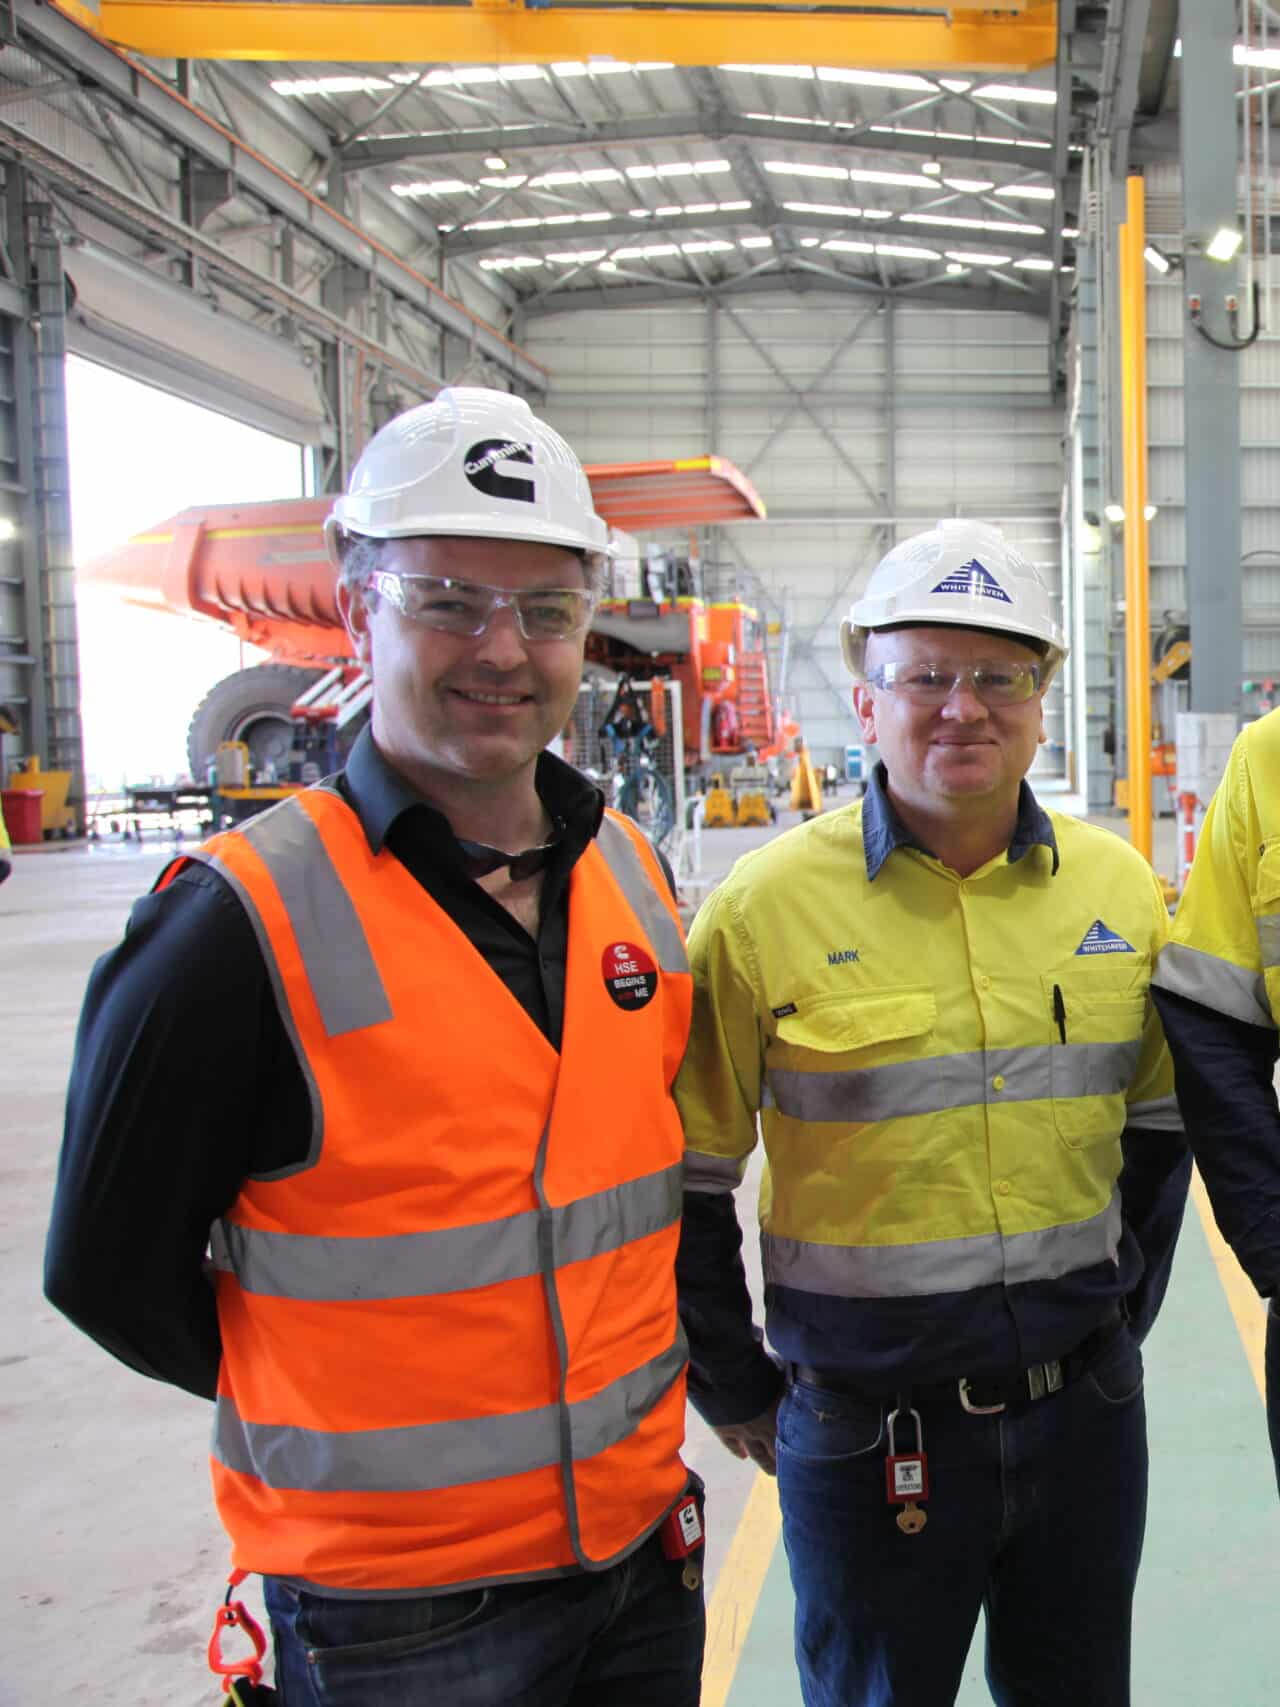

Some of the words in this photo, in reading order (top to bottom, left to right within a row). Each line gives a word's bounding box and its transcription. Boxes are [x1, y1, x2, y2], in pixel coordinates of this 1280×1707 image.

[464, 442, 530, 475] Cummin
[940, 583, 1004, 598] WHITAVEN
[828, 949, 860, 965] MARK
[614, 961, 639, 975] HSE
[614, 976, 647, 989] BEGINS
[635, 987, 649, 998] ME
